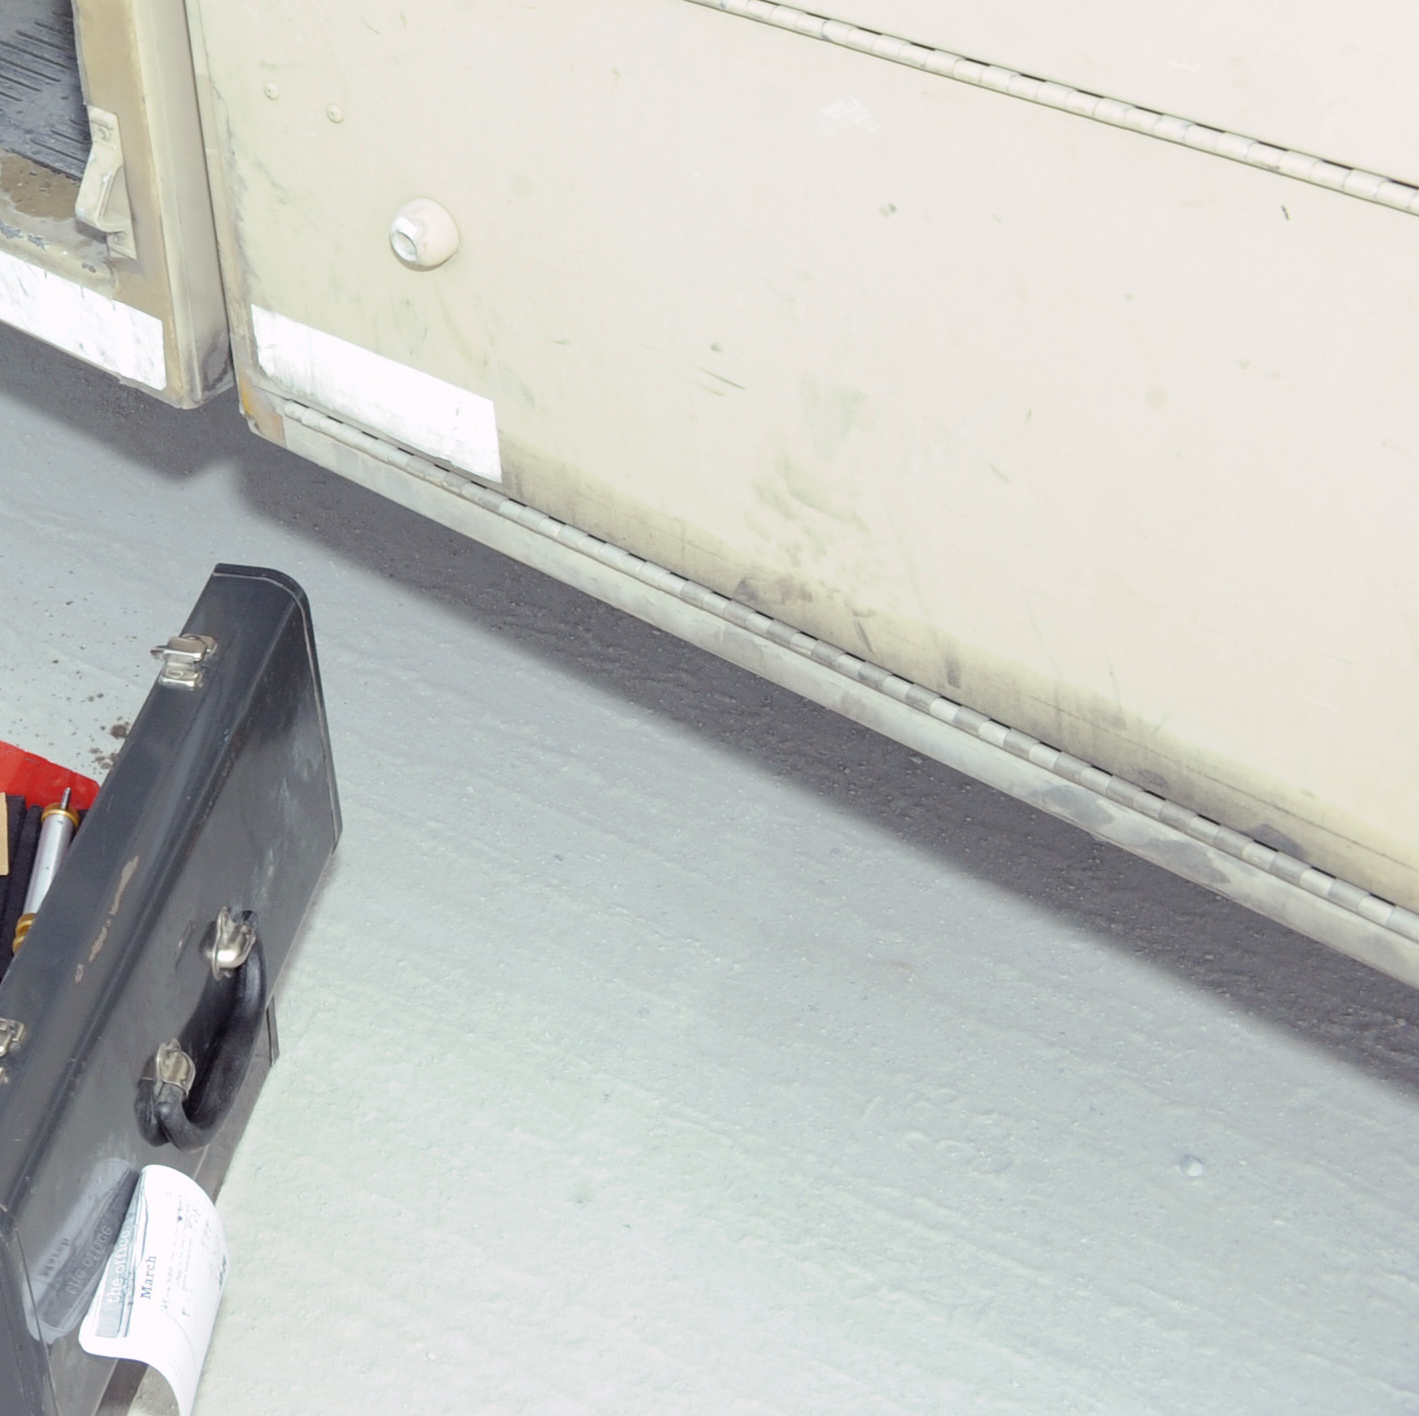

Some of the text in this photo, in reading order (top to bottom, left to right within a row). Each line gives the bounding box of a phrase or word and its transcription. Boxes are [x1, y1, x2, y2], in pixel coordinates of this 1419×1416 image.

[106, 1228, 131, 1304] the office
[139, 1255, 157, 1301] March
